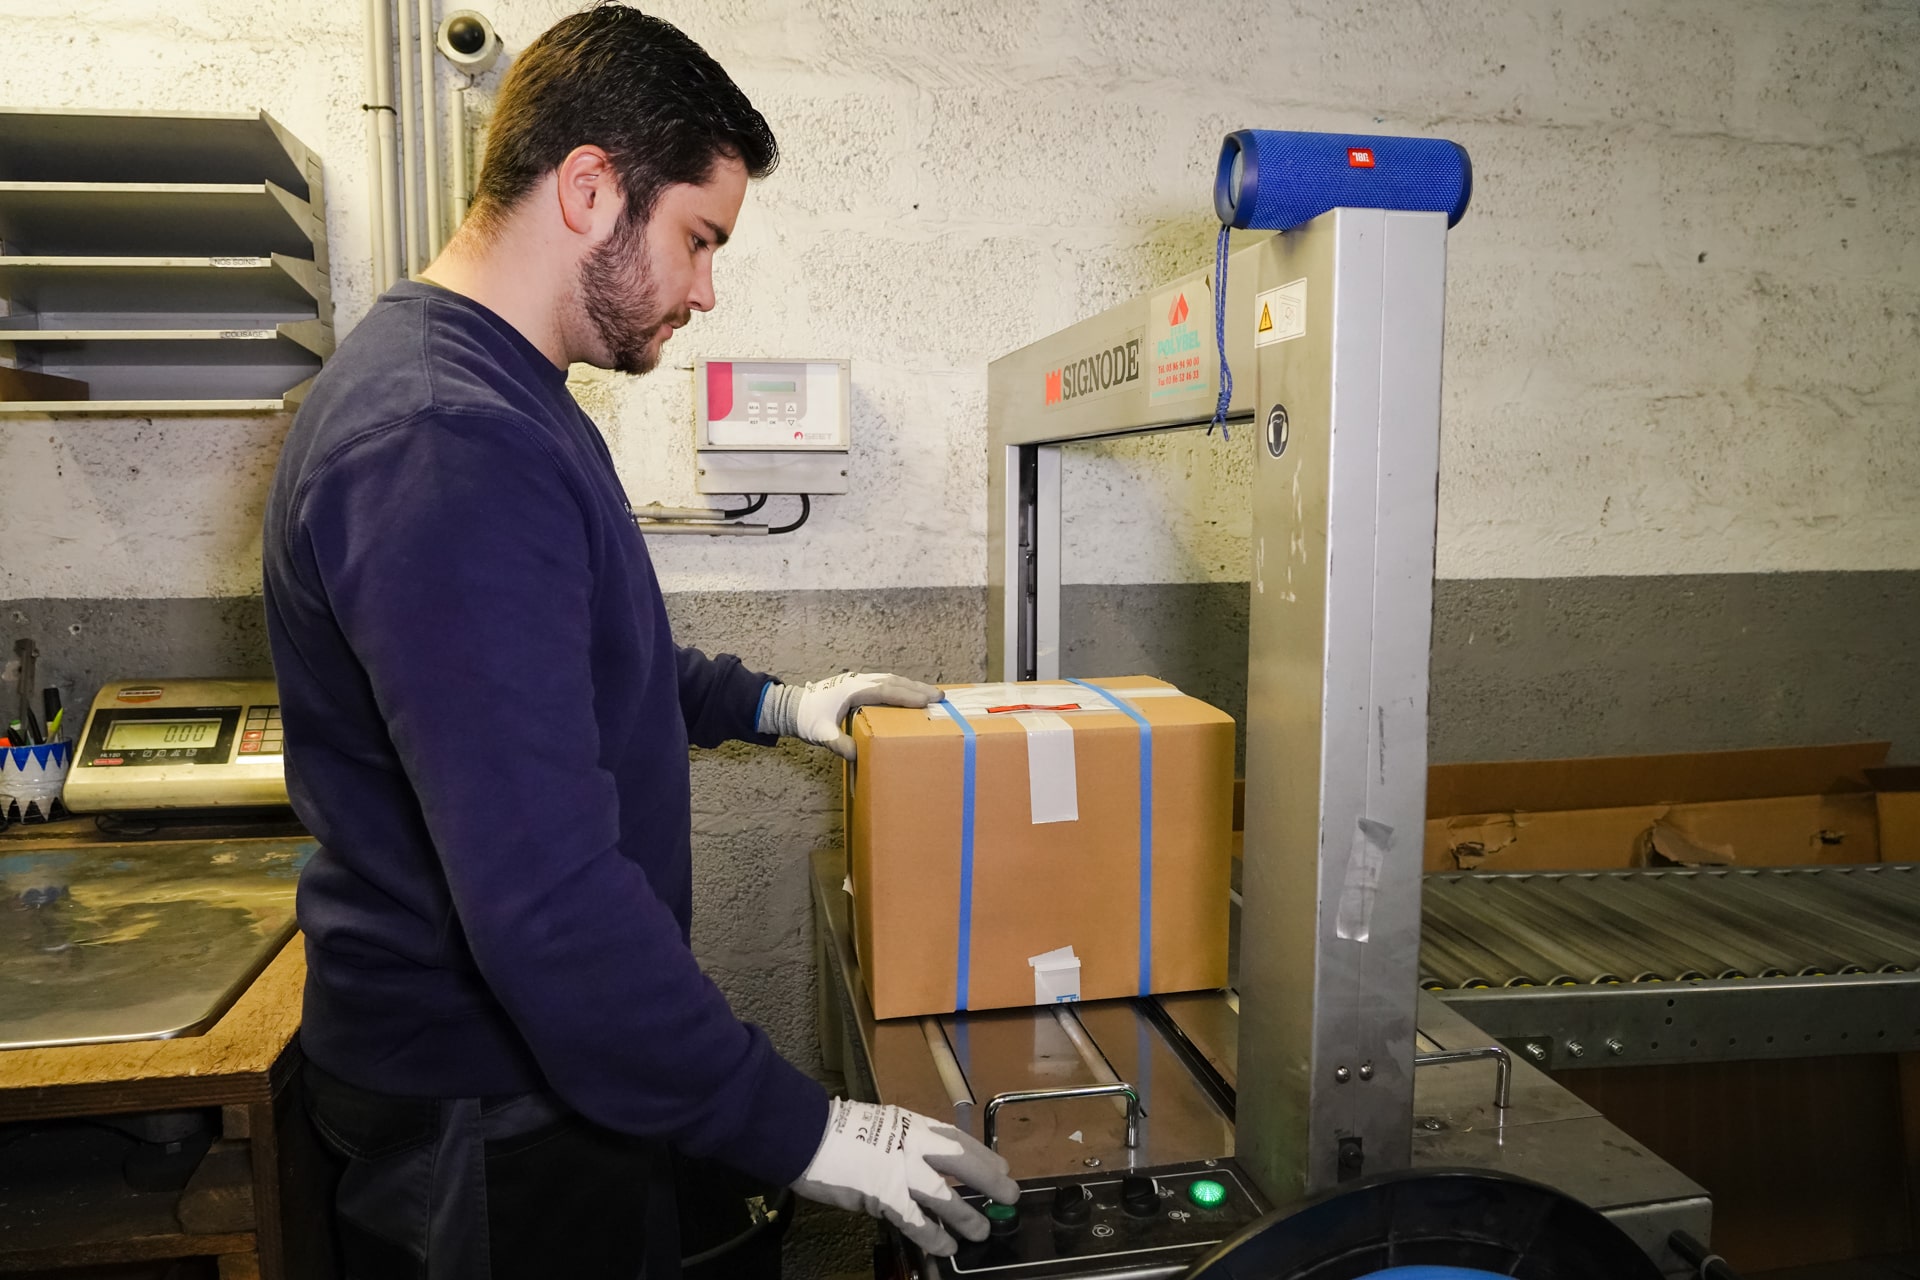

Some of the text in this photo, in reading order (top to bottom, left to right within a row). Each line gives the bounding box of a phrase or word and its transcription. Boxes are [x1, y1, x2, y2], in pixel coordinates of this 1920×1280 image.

[1351, 151, 1370, 163] JBL
[1062, 338, 1139, 401] SIGNODE
[163, 725, 207, 743] 0.00
[885, 1131, 896, 1154] foam
